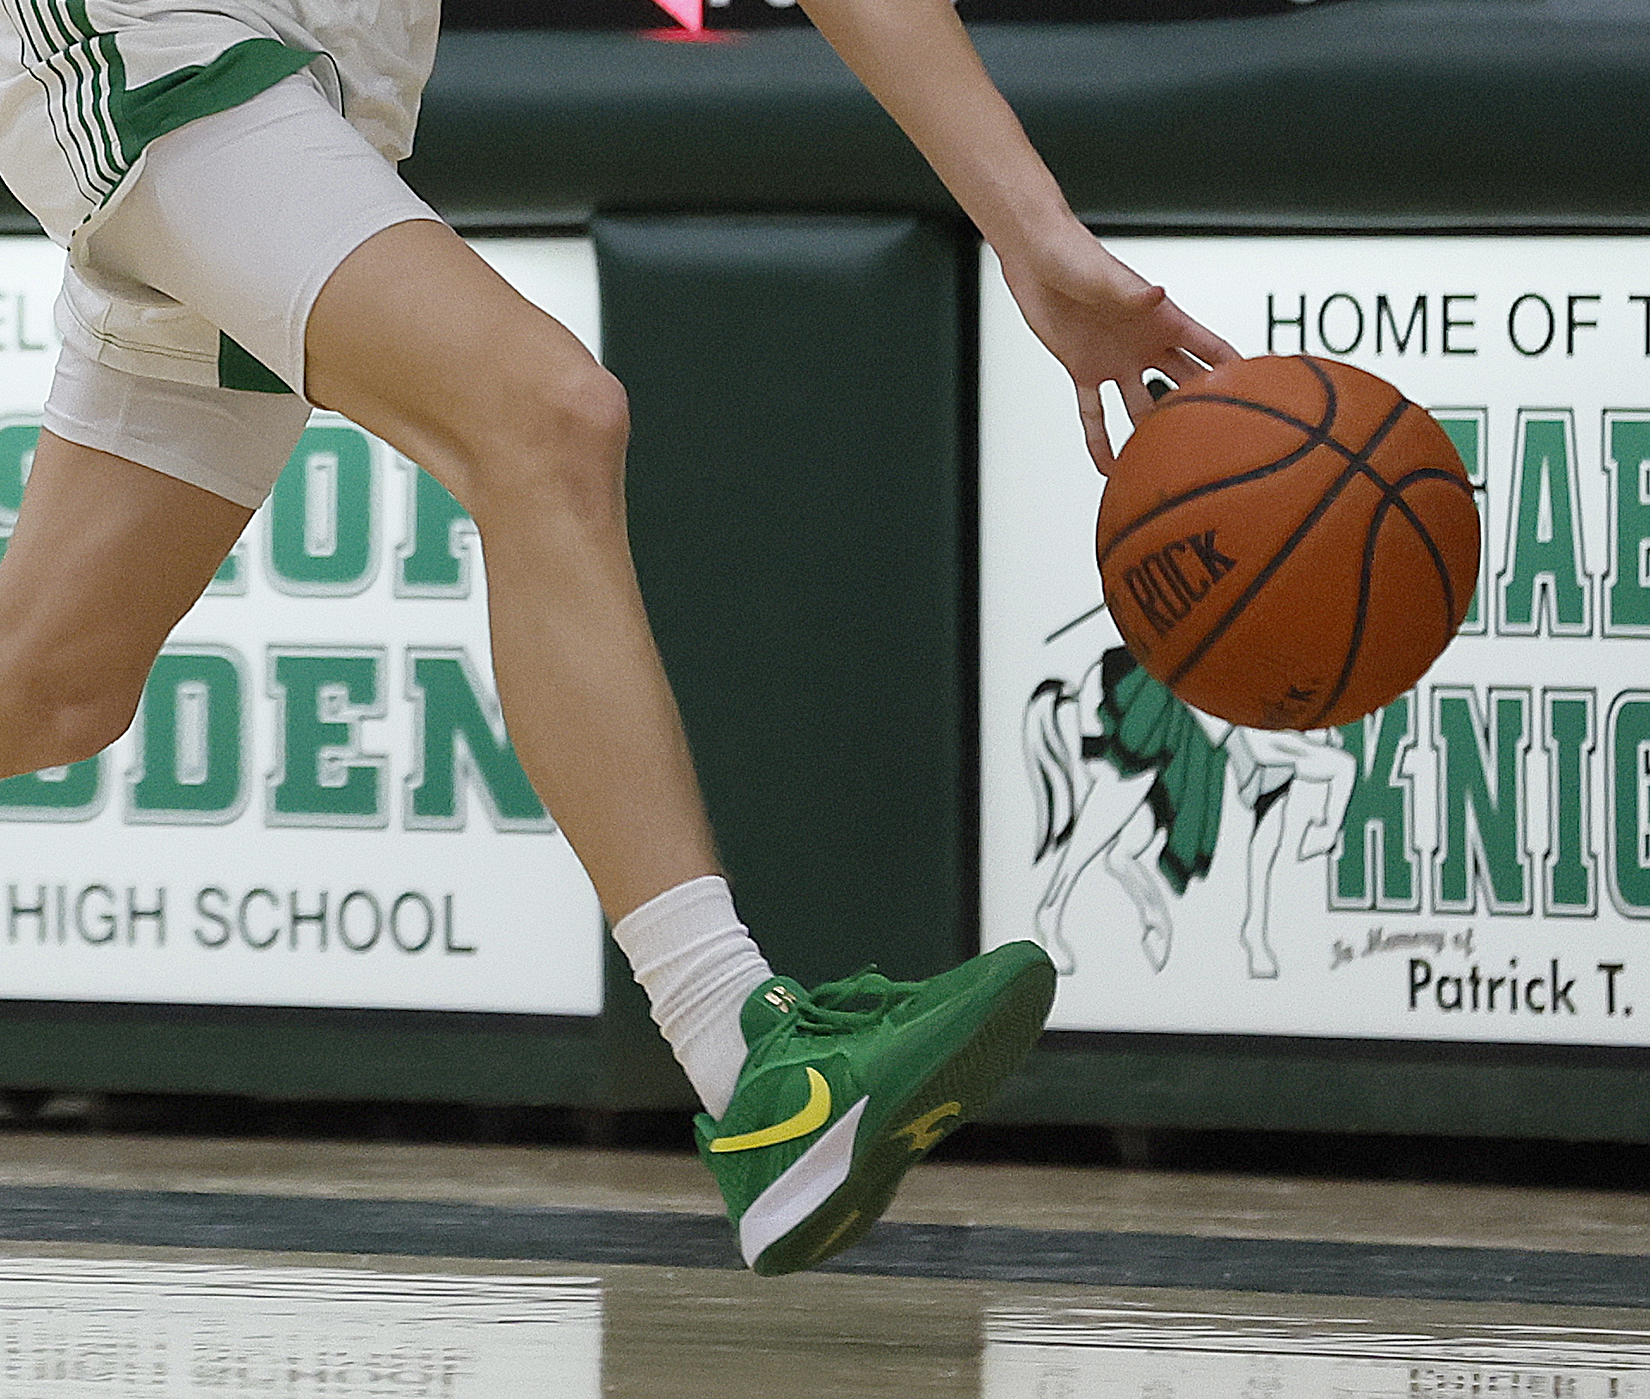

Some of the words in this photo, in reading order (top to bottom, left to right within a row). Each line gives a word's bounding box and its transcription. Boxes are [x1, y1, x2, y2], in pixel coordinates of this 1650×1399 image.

[1267, 294, 1477, 356] HOME
[1508, 294, 1601, 356] OF
[1122, 528, 1237, 640] ROCK
[7, 883, 167, 947] HIGH
[194, 886, 478, 955] SCHOOL
[1407, 957, 1577, 1015] Patrick
[1598, 962, 1634, 1017] T.
